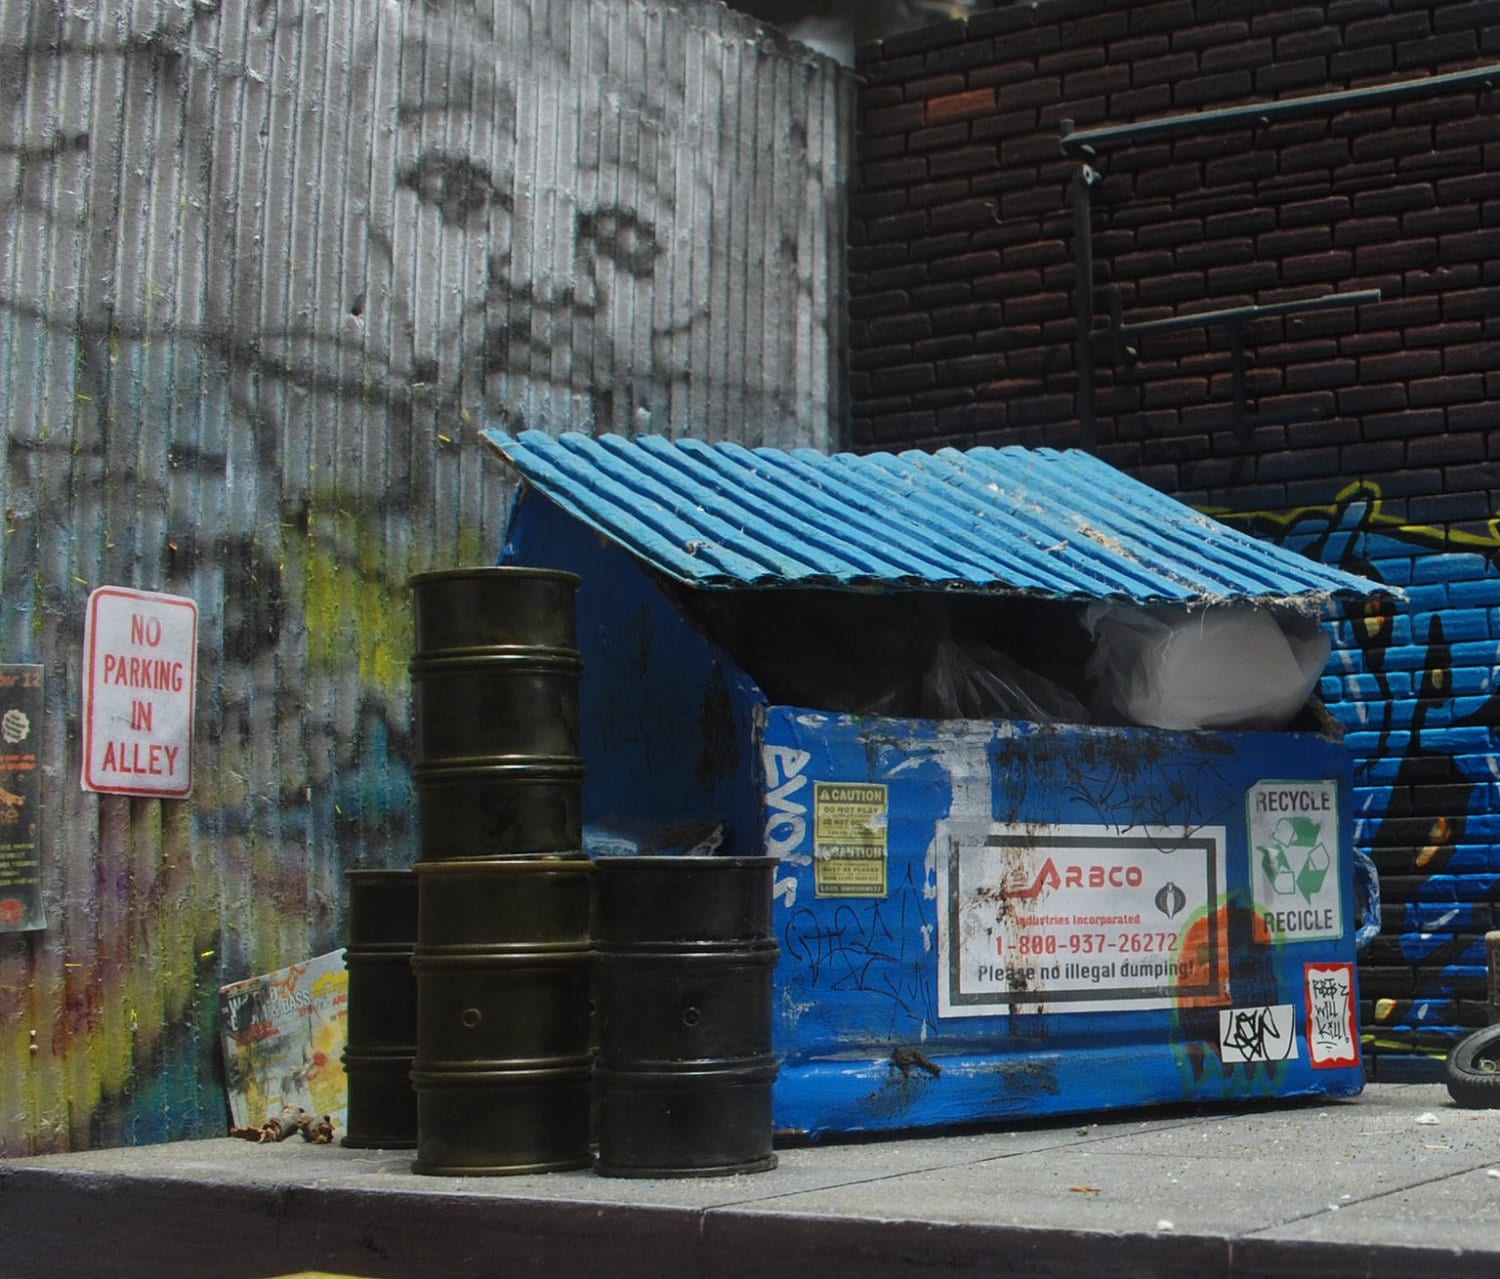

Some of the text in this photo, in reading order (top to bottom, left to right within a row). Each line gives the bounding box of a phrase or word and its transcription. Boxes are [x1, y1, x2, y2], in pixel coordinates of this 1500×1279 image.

[131, 614, 162, 648] NO
[103, 654, 184, 692] PARKING
[131, 700, 153, 733] IN
[102, 741, 180, 776] ALLEY
[832, 789, 881, 802] CAUTION
[1256, 790, 1331, 813] RECYCLE
[824, 806, 878, 814] DO NOT PLAY
[832, 846, 881, 859] CAUTION
[1263, 909, 1333, 934] RECICLE
[996, 932, 1178, 956] 1-800-937-26272
[977, 959, 1194, 983] Please no illegal dumping!
[282, 989, 311, 1014] BASS
